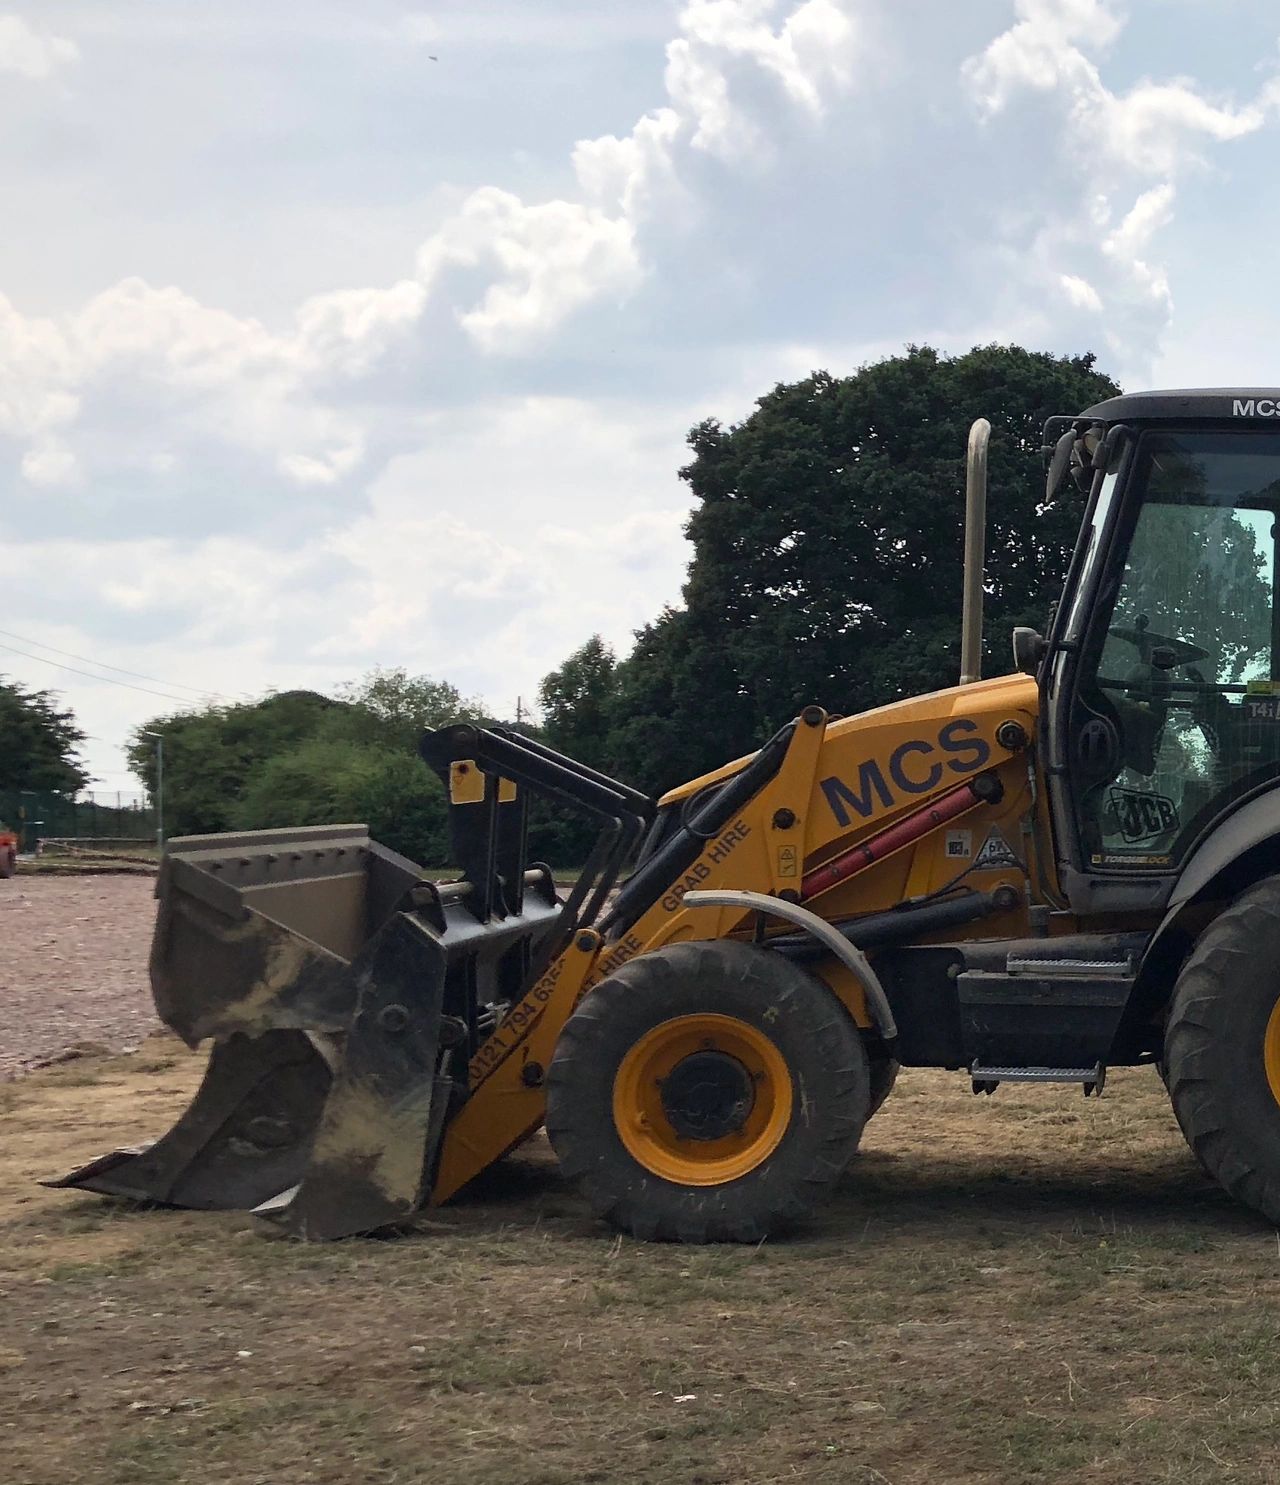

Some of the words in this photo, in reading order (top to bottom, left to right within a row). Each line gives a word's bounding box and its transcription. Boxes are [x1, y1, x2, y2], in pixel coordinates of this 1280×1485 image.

[820, 718, 991, 828] MCS
[1121, 793, 1178, 838] JCB
[662, 863, 711, 912] GRAB
[707, 819, 752, 864] HIRE
[502, 1002, 537, 1035] 794
